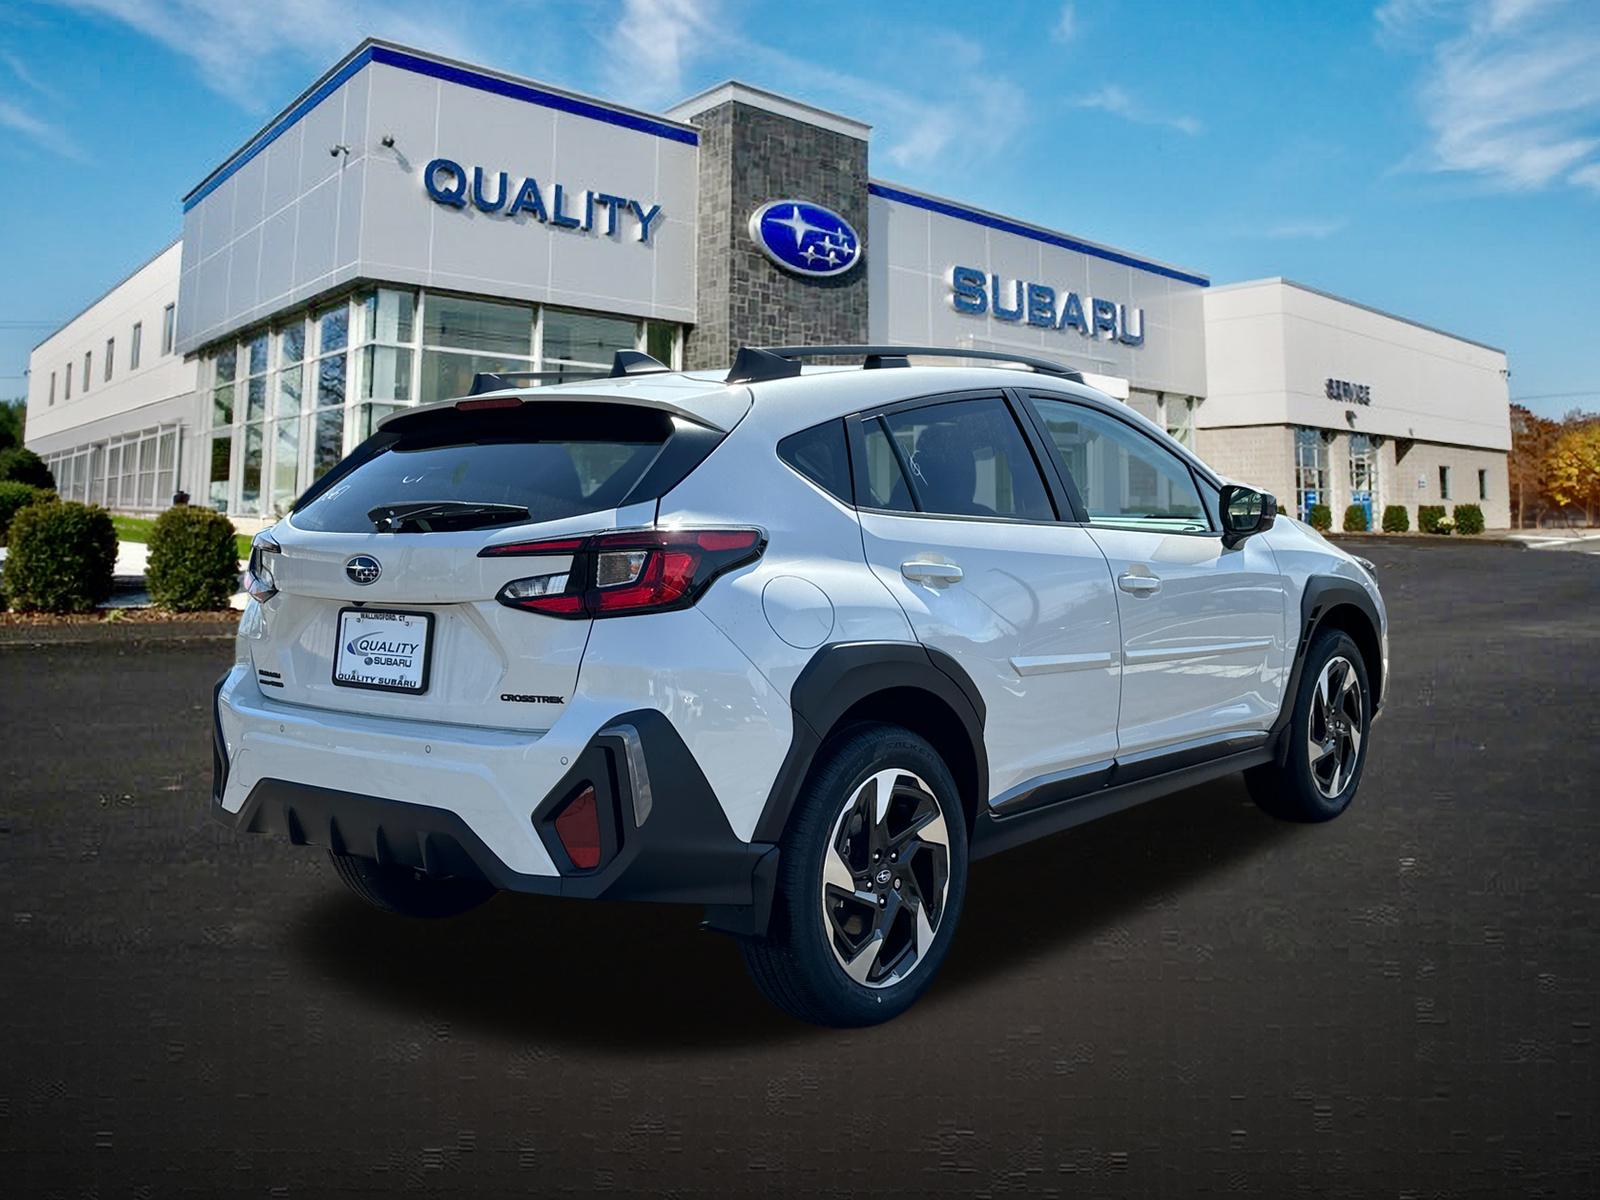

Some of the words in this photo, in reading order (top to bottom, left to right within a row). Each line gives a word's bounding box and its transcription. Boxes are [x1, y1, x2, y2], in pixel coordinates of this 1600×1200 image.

[424, 158, 662, 242] QUALITY
[951, 265, 1146, 346] SUBARU
[1325, 378, 1370, 406] SERVICE
[359, 640, 419, 654] QUALITY
[373, 657, 412, 667] SUBARU
[337, 673, 376, 684] QUALITY
[378, 677, 417, 687] SUBARU
[500, 694, 565, 704] CROSSTREK
